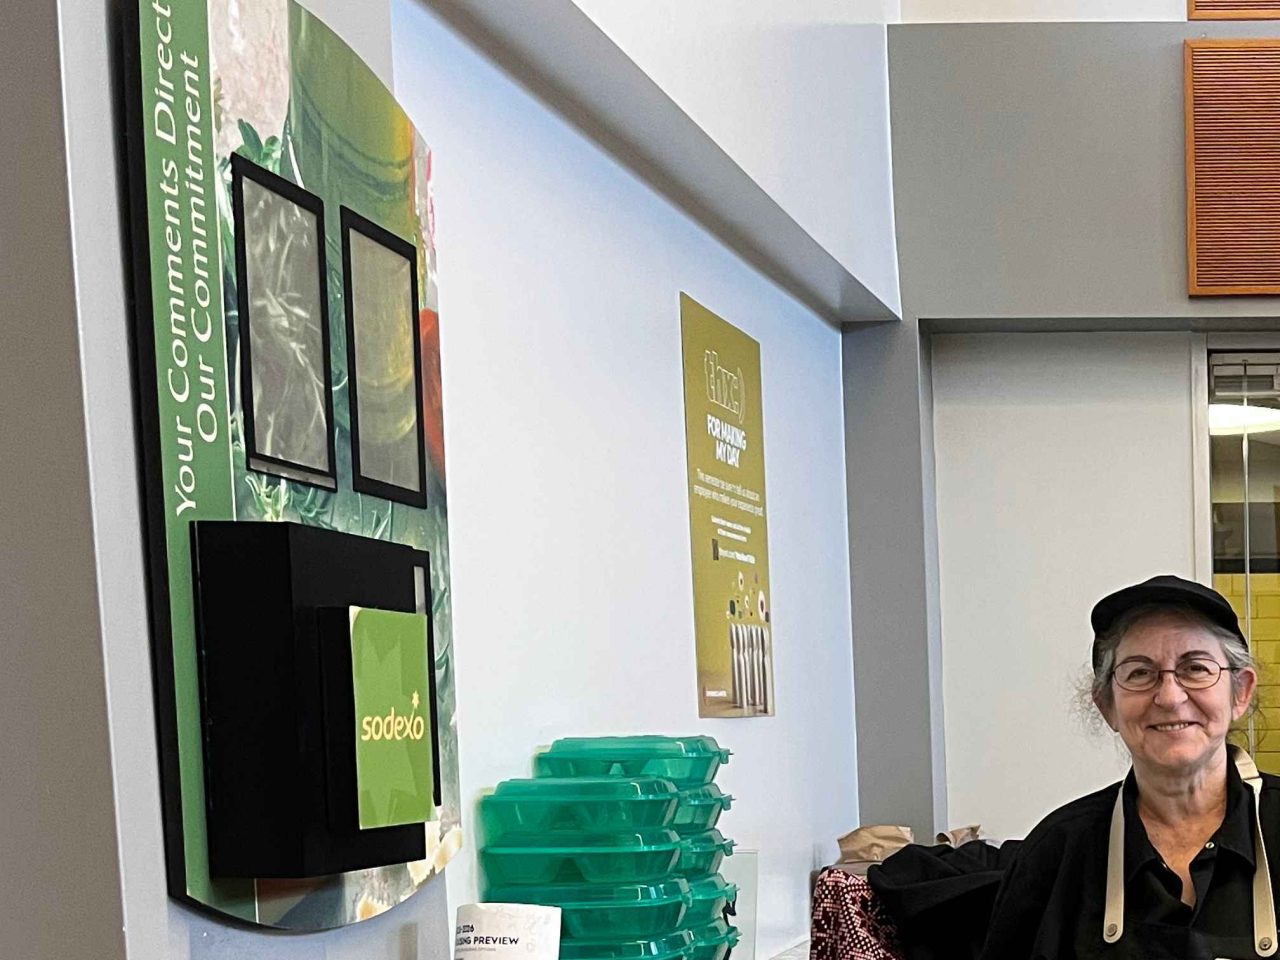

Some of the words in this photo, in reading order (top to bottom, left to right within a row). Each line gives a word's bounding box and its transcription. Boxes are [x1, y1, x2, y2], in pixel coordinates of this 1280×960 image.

[154, 0, 176, 145] Direct
[181, 50, 213, 343] Commitment
[163, 166, 189, 402] Comments
[194, 362, 216, 442] Our
[707, 415, 720, 437] FOR
[721, 421, 746, 450] MAKING
[176, 413, 192, 515] Your
[716, 440, 726, 462] MY
[727, 445, 740, 467] DAY
[361, 707, 424, 740] sodexo
[474, 936, 519, 944] PREVIEW
